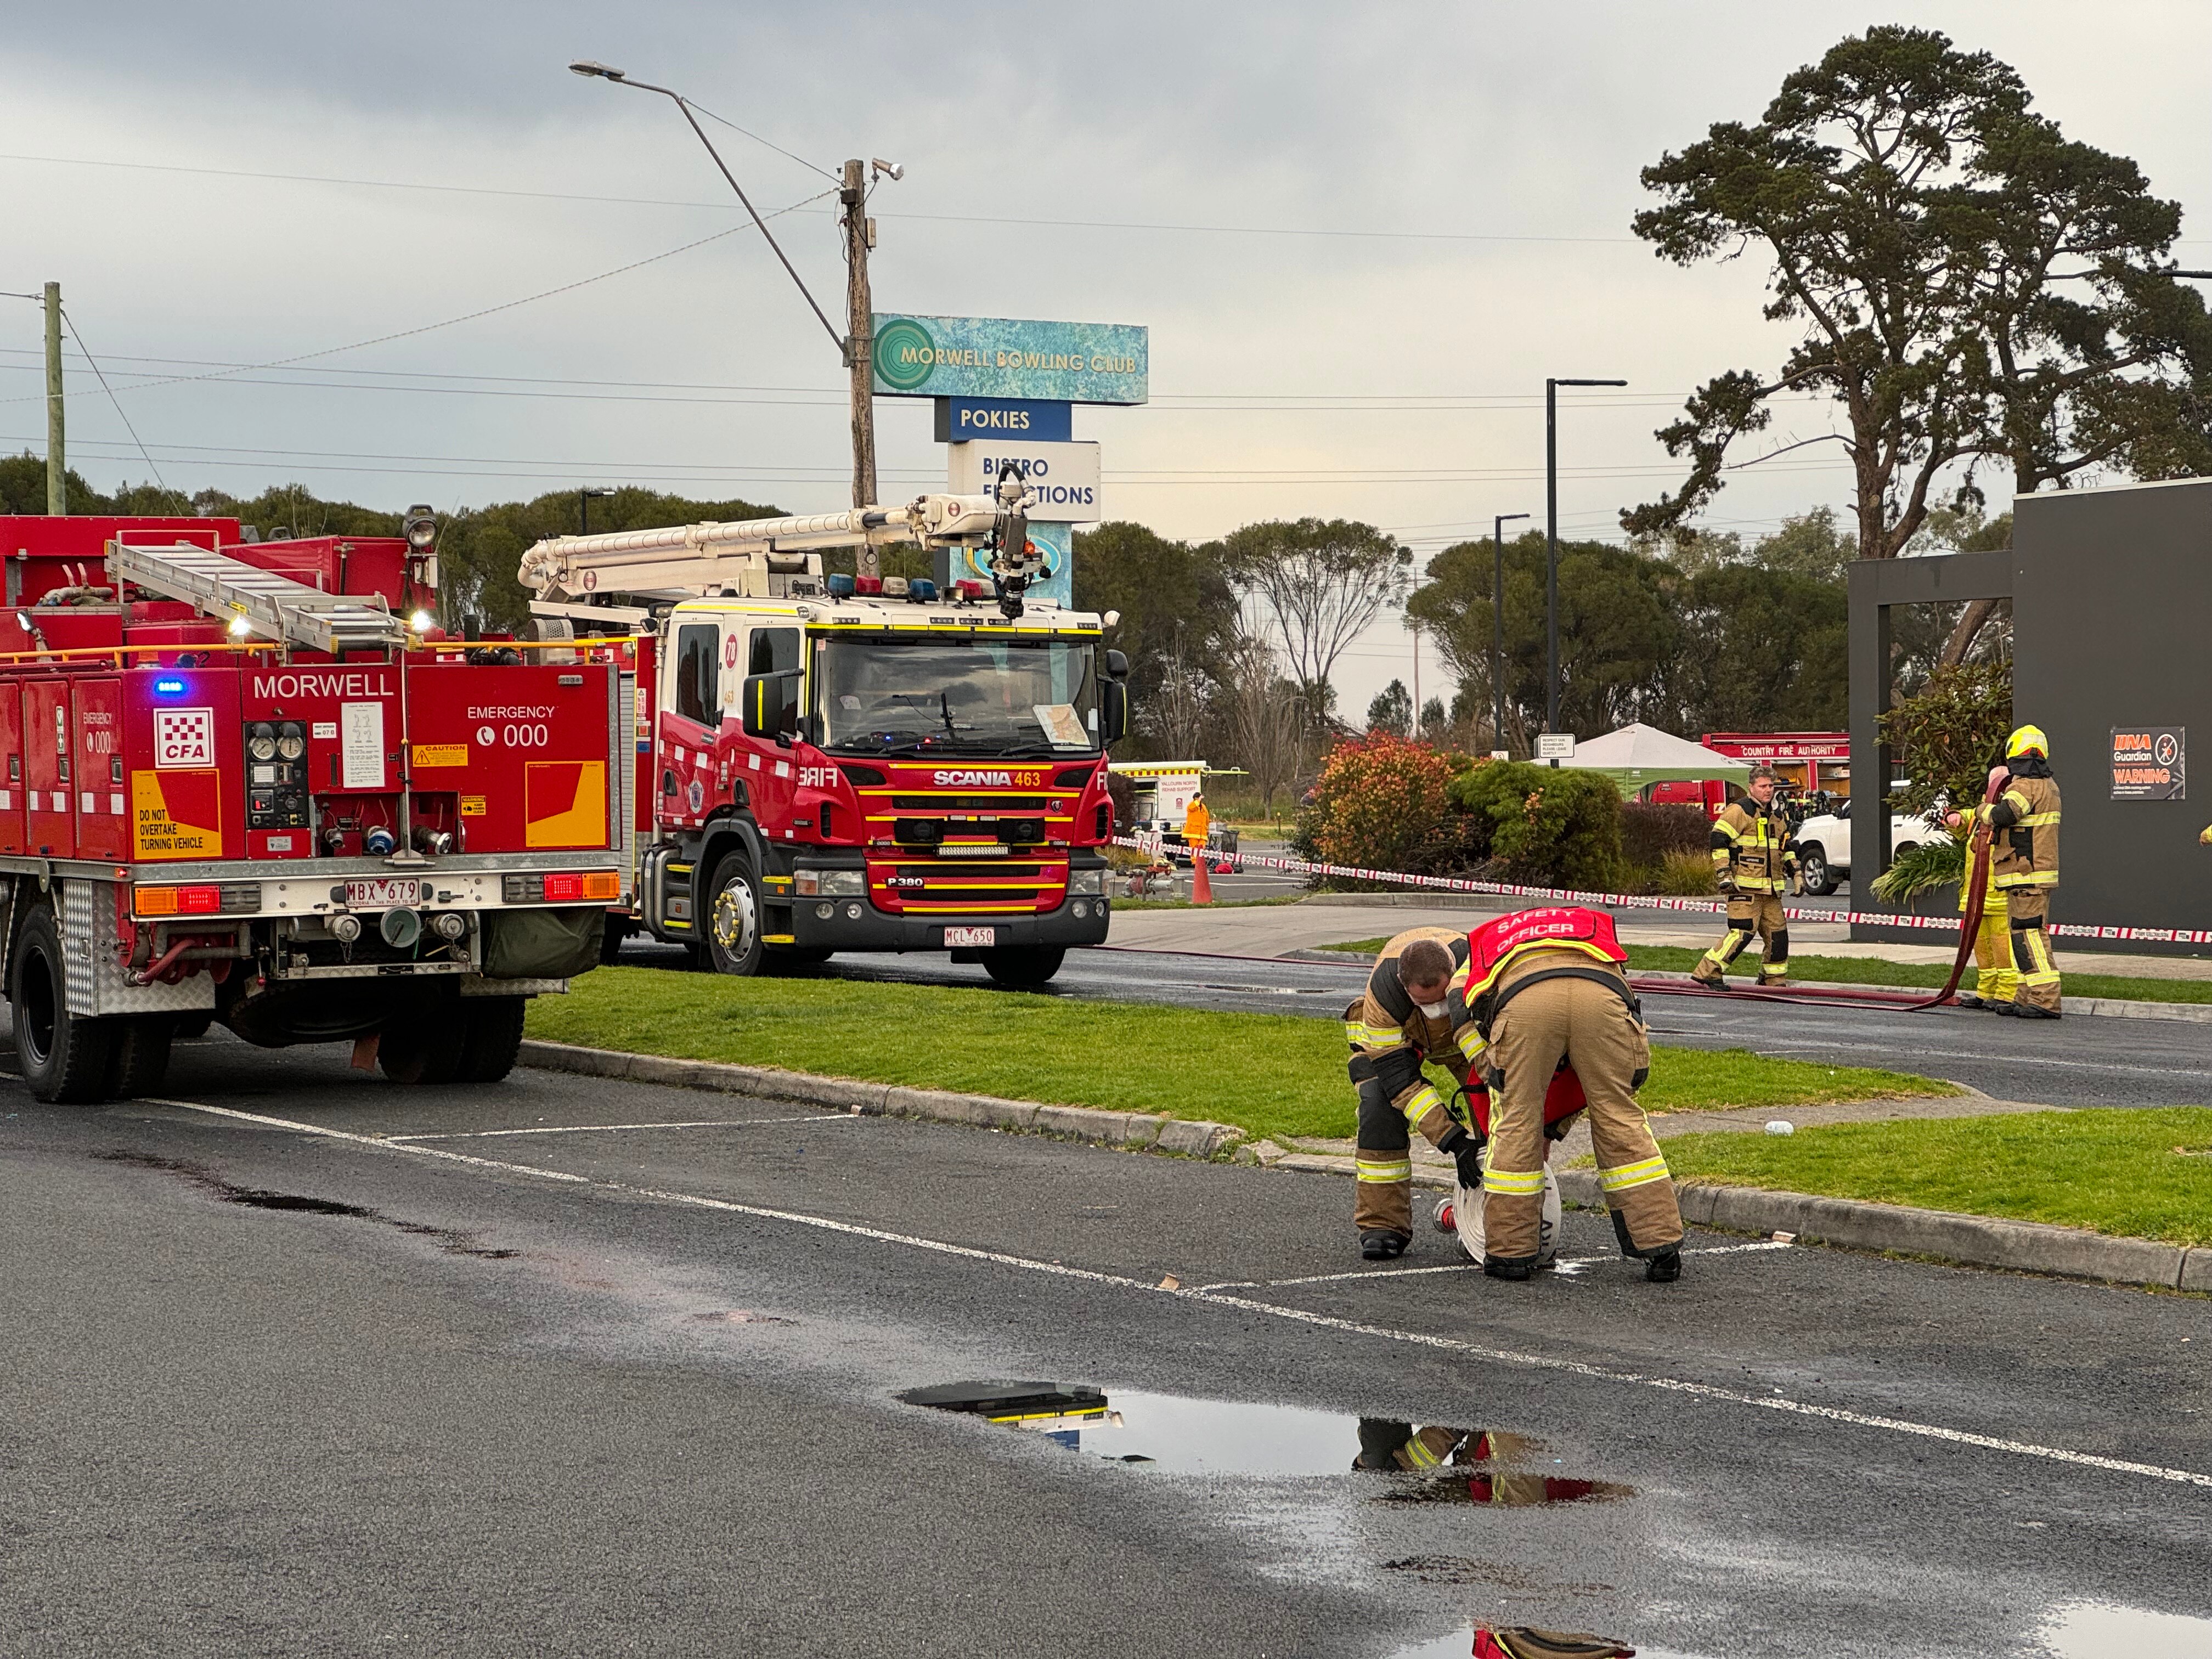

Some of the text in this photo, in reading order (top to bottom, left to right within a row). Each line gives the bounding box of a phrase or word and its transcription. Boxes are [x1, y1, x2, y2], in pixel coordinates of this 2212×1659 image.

[900, 347, 1136, 373] MORWELL BOWLING CLUB
[961, 409, 1030, 429] POKIES
[727, 641, 736, 661] 78
[254, 674, 394, 698] MORWELL
[83, 712, 112, 724] EMERGENCY
[467, 706, 555, 719] EMERGENCY
[95, 731, 110, 753] 000
[504, 724, 548, 747] 000
[2114, 734, 2152, 751] DNA
[166, 744, 205, 758] CFA
[1743, 746, 1836, 756] COUNTRY FIRE AUTHORITY
[2114, 751, 2152, 761] Guardian
[933, 771, 1040, 787] SCANIA 463
[2113, 768, 2170, 784] WARNING
[139, 809, 166, 821] DO NOT
[140, 823, 177, 836] OVERTAKE
[140, 837, 203, 850] TURNING VEHICLE
[347, 882, 415, 900] MBX 679
[1497, 909, 1576, 934] SAFETY
[946, 930, 992, 942] MCL 650
[1497, 923, 1574, 953] OFFICER
